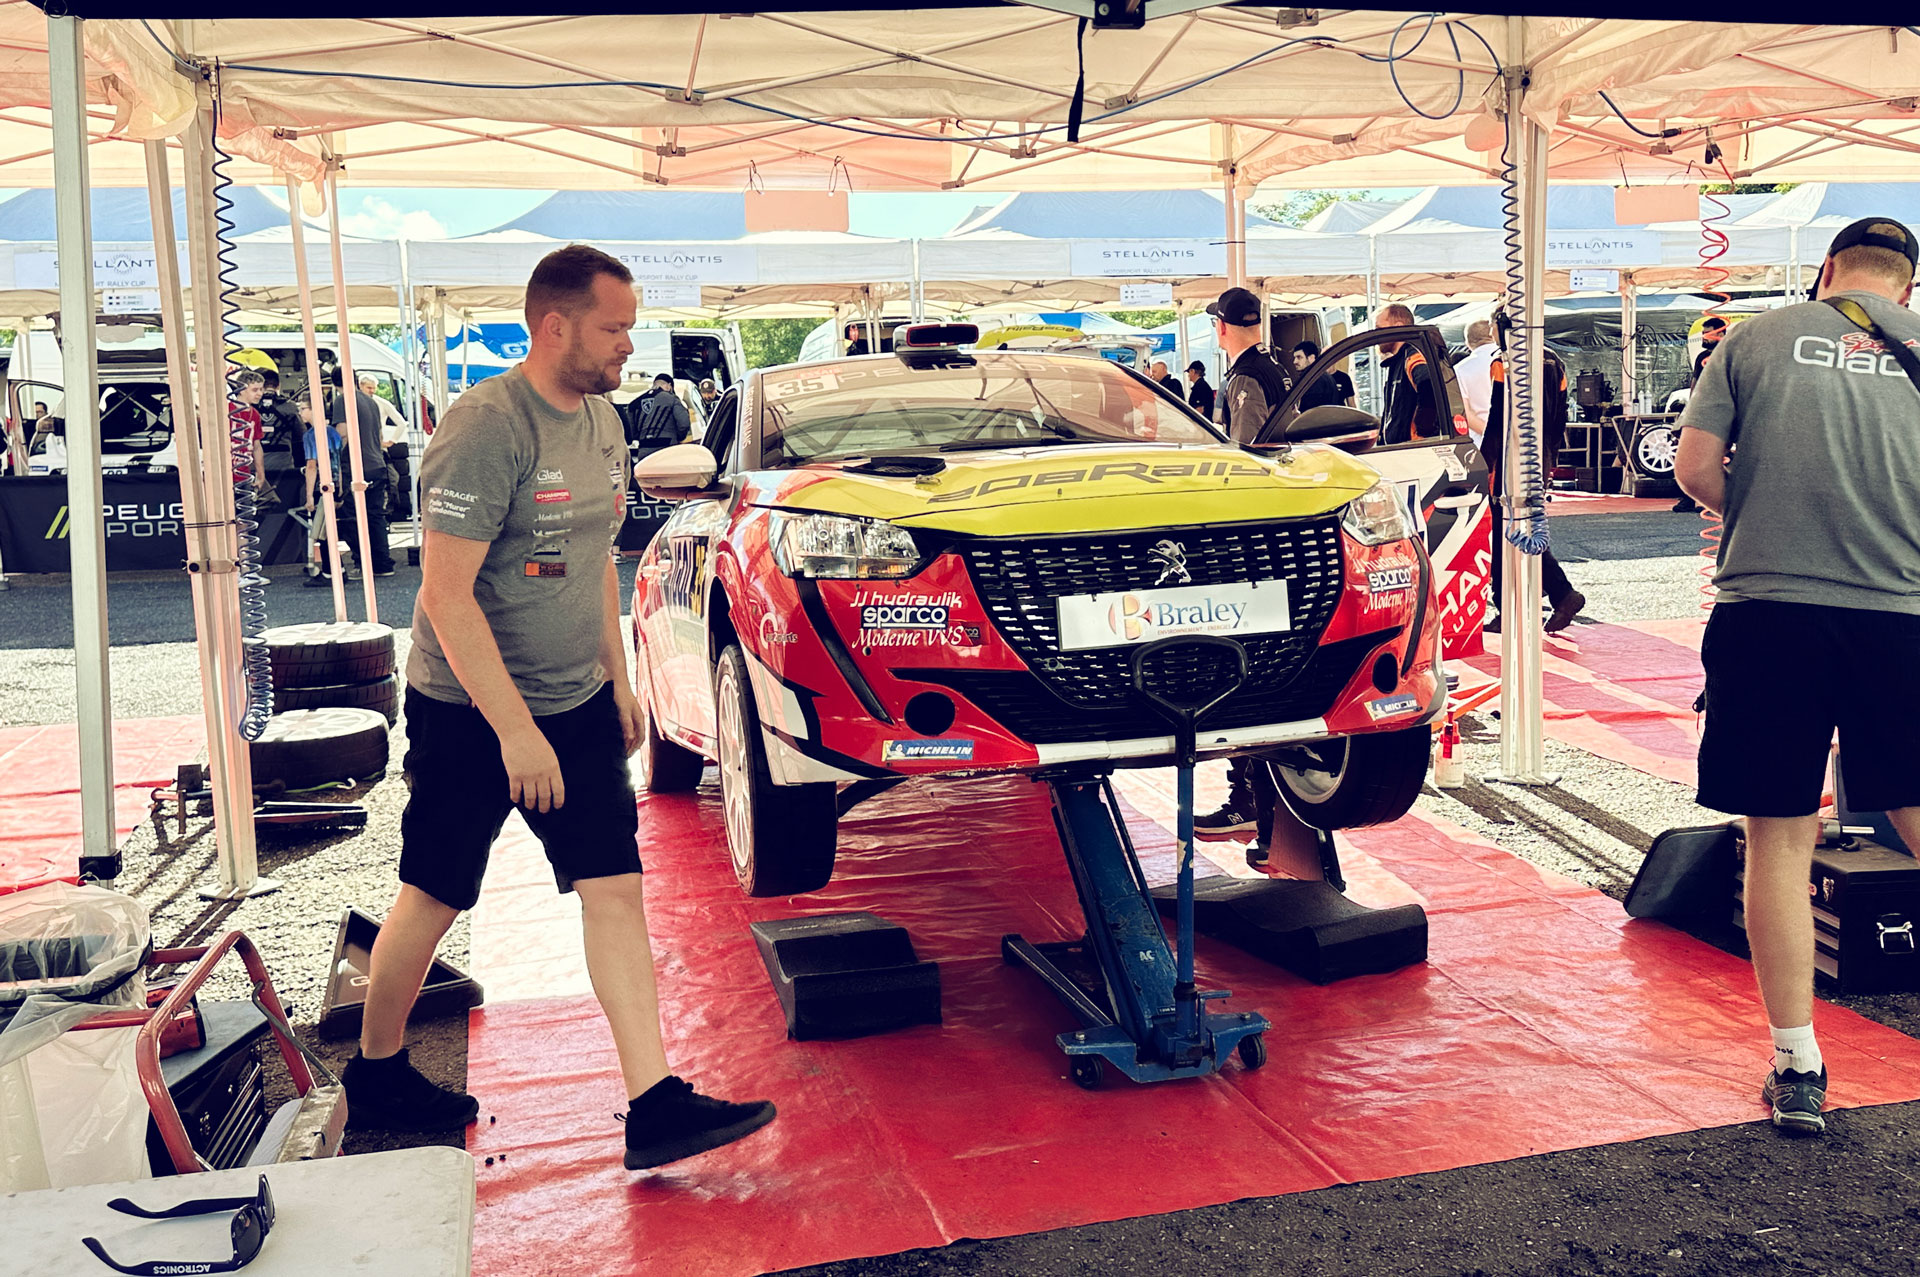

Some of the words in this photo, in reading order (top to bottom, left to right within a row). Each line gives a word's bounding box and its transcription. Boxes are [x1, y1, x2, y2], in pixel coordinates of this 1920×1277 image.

[1548, 241, 1634, 249] STELLANTIS
[619, 255, 723, 264] STELLANTIS
[1102, 250, 1195, 258] STELLANTIS
[53, 259, 155, 268] SLLANT
[107, 280, 129, 288] RALLY
[130, 280, 147, 288] CUP
[837, 362, 1078, 383] PEUGEOT
[777, 377, 825, 397] 35
[536, 469, 564, 481] Glad
[1368, 568, 1411, 592] sparco
[1364, 591, 1404, 614] Moderne
[863, 606, 948, 629] sparco
[1156, 598, 1248, 629] Braley
[851, 627, 921, 649] Moderne
[925, 625, 965, 646] VVS
[906, 746, 973, 755] MICHELIN
[153, 1263, 212, 1275] ACTRONICS
